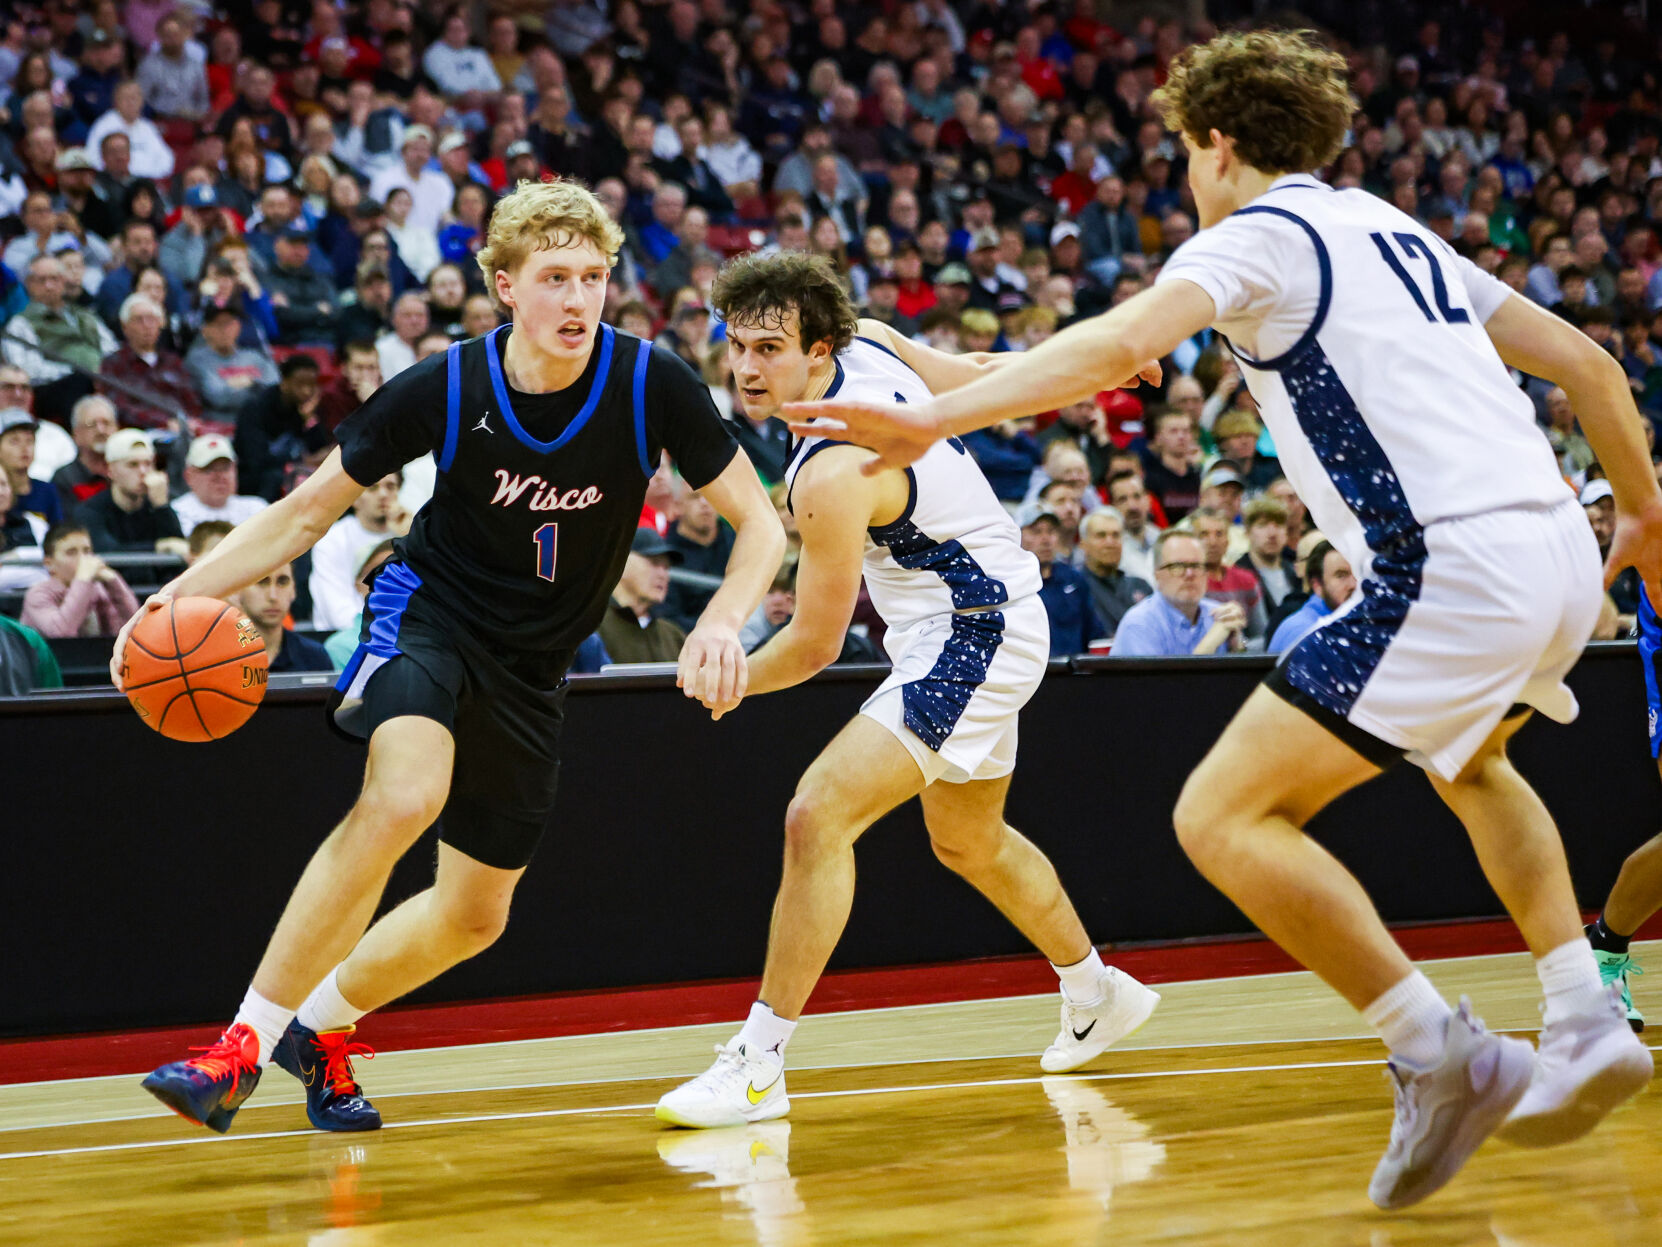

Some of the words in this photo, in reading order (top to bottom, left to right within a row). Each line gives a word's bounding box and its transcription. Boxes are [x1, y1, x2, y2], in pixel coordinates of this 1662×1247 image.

[1368, 231, 1472, 325] 12
[490, 469, 603, 511] Wisco
[532, 522, 559, 583] 1
